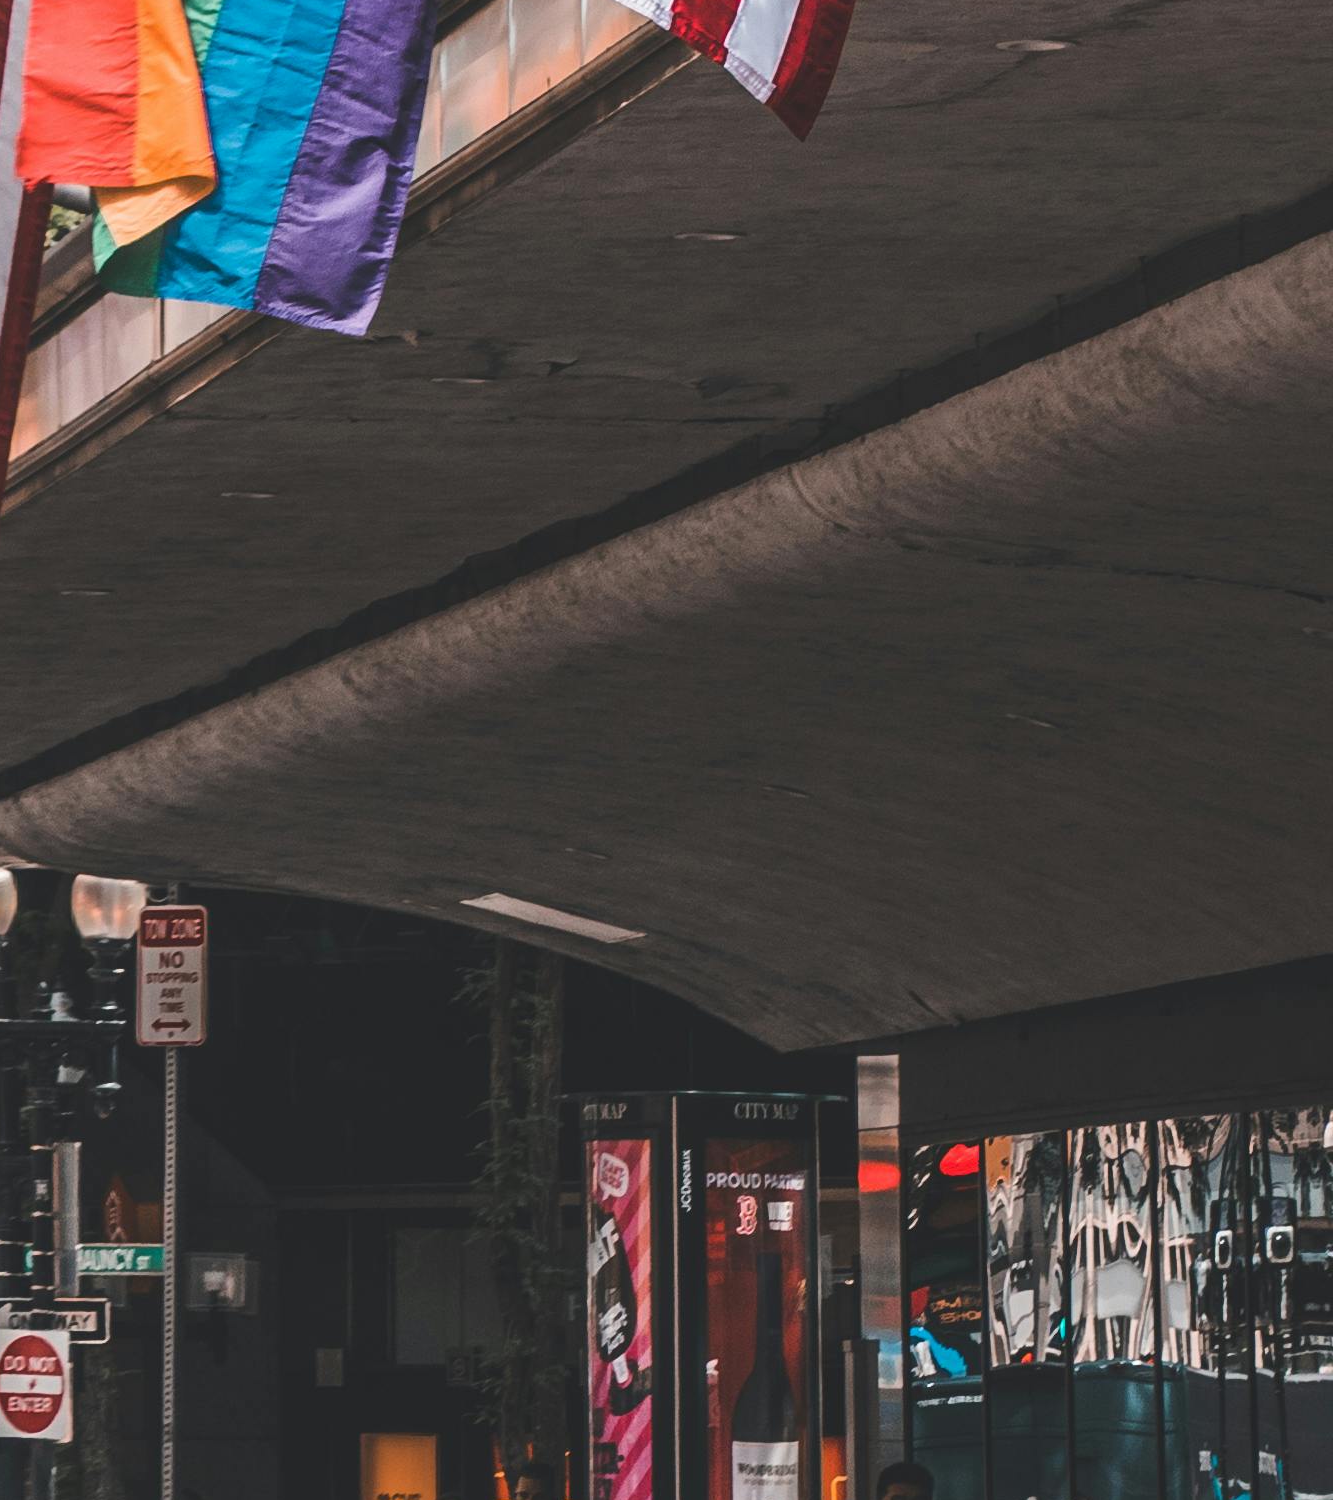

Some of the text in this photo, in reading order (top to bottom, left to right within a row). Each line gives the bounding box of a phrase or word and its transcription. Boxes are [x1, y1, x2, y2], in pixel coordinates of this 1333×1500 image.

[158, 951, 185, 969] NO
[145, 971, 199, 984] STOPPING
[159, 987, 183, 999] ANY
[158, 1002, 185, 1013] TIME
[734, 1102, 768, 1120] CITY
[680, 1150, 692, 1212] JCDecaux
[705, 1172, 762, 1189] PROUD
[3, 1356, 57, 1372] DO NOT
[7, 1397, 54, 1413] ENTER
